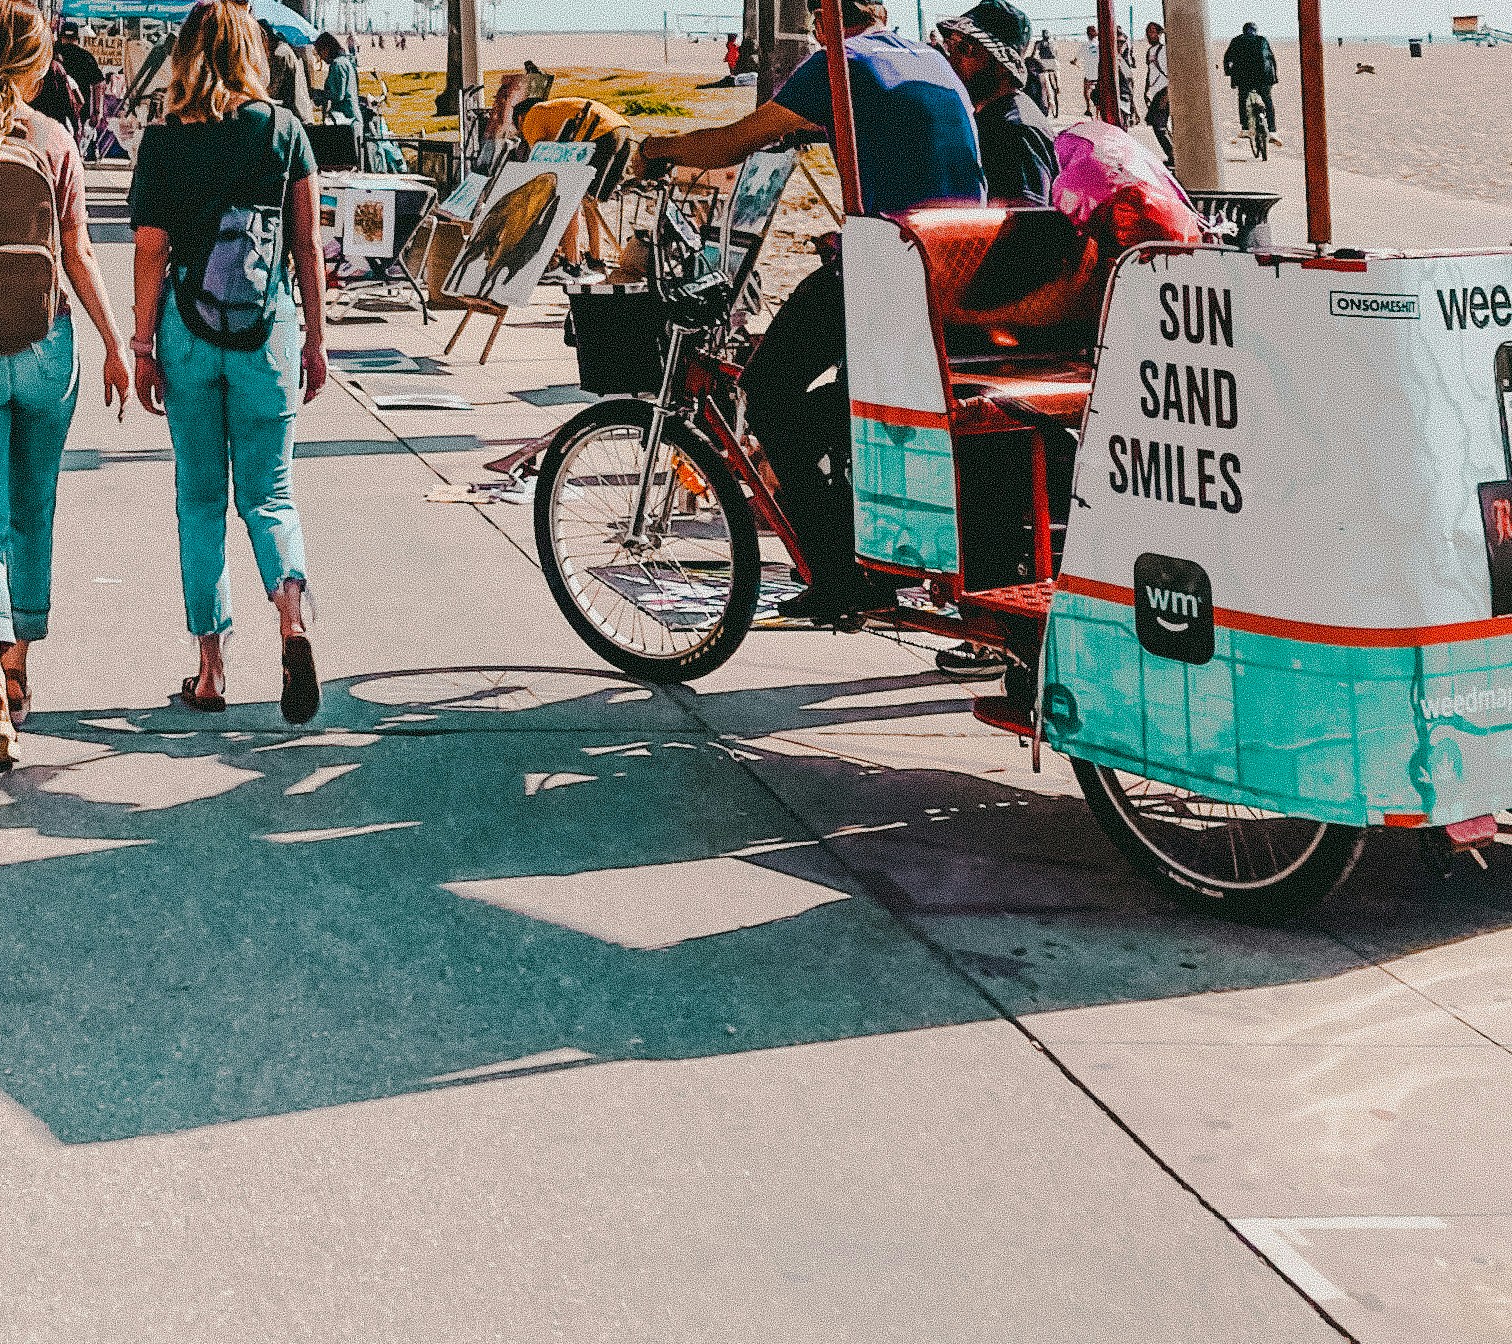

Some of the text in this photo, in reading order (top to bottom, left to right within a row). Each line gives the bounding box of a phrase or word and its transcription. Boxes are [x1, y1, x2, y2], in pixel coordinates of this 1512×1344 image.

[1159, 281, 1235, 349] SUN
[1139, 359, 1239, 431] SAND
[1108, 434, 1244, 515] SMILES
[1144, 585, 1200, 619] wm
